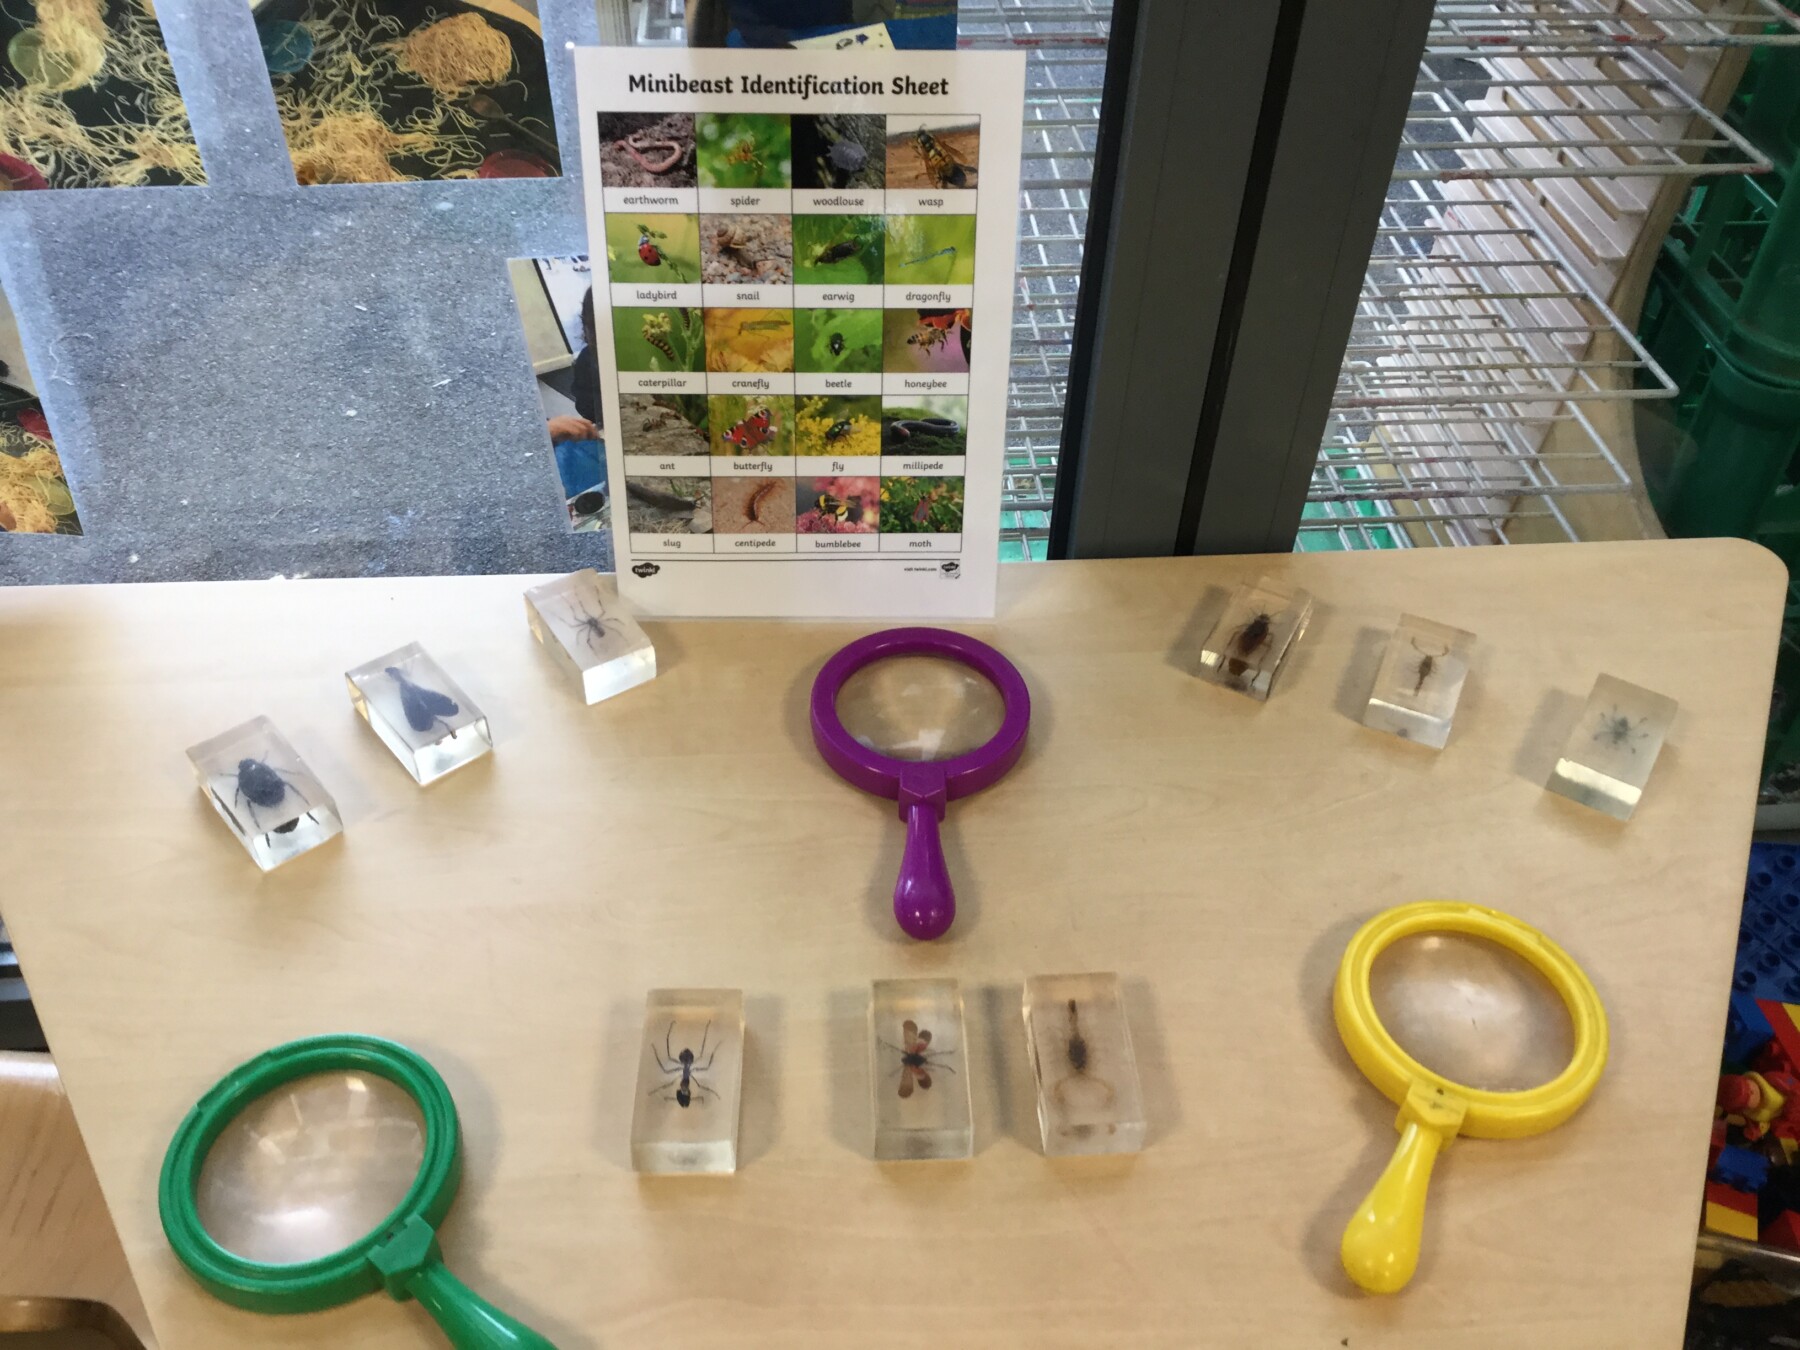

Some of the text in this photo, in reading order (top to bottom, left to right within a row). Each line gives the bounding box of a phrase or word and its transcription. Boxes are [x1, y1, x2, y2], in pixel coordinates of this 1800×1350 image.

[629, 73, 949, 100] Minibeast Identification Sheet
[623, 195, 678, 205] earthworm
[731, 196, 760, 207] spider
[813, 196, 864, 206] woodlouse
[919, 199, 943, 208] wasp
[637, 291, 677, 302] ladybird
[737, 291, 760, 300] snail
[822, 292, 854, 303] earwig
[906, 291, 951, 303] dragonfly
[638, 379, 686, 388] caterpillar
[732, 379, 769, 389] cranefly
[825, 379, 852, 388] beetle
[905, 379, 947, 390] honeybee
[734, 462, 772, 472] butterfly
[832, 462, 844, 472] fly
[903, 461, 943, 471] millipede
[663, 539, 681, 548] slug
[735, 539, 775, 548] centipede
[815, 540, 861, 548] bumblebee
